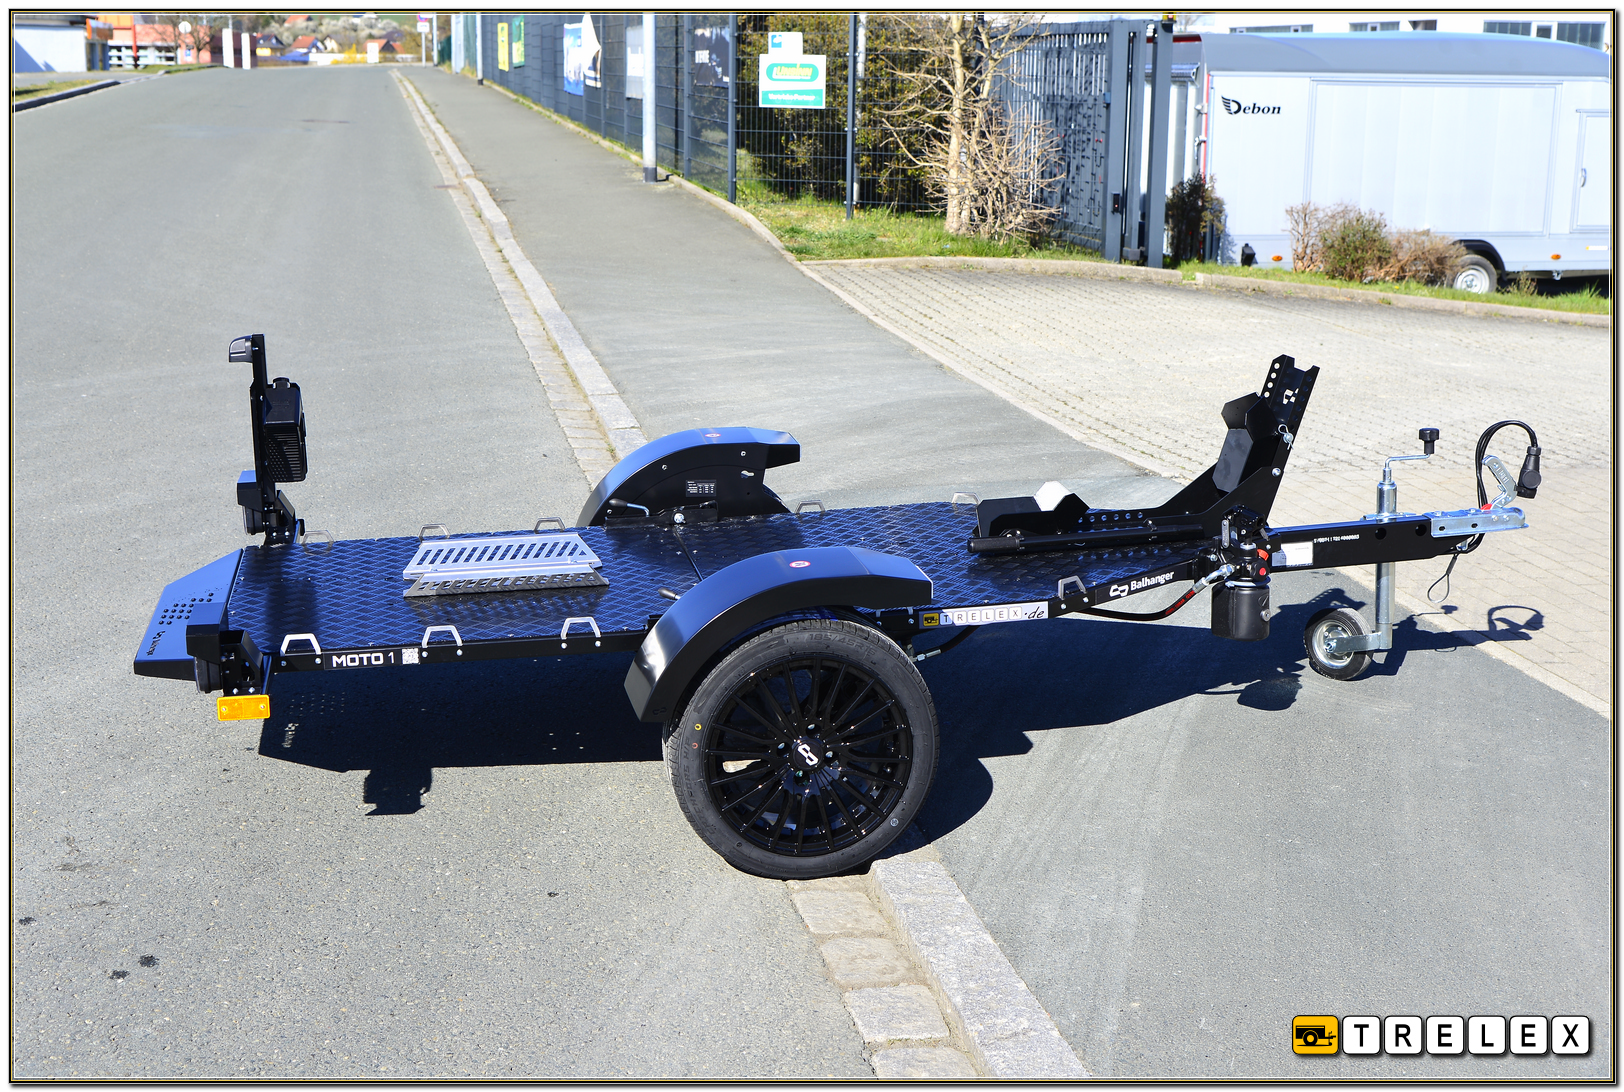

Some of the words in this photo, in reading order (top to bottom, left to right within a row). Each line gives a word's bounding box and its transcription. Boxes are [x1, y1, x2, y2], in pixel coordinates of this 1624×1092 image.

[1221, 95, 1281, 115] Debon
[1130, 571, 1175, 591] Balhanger
[332, 652, 384, 668] MOTO
[387, 651, 395, 664] 1
